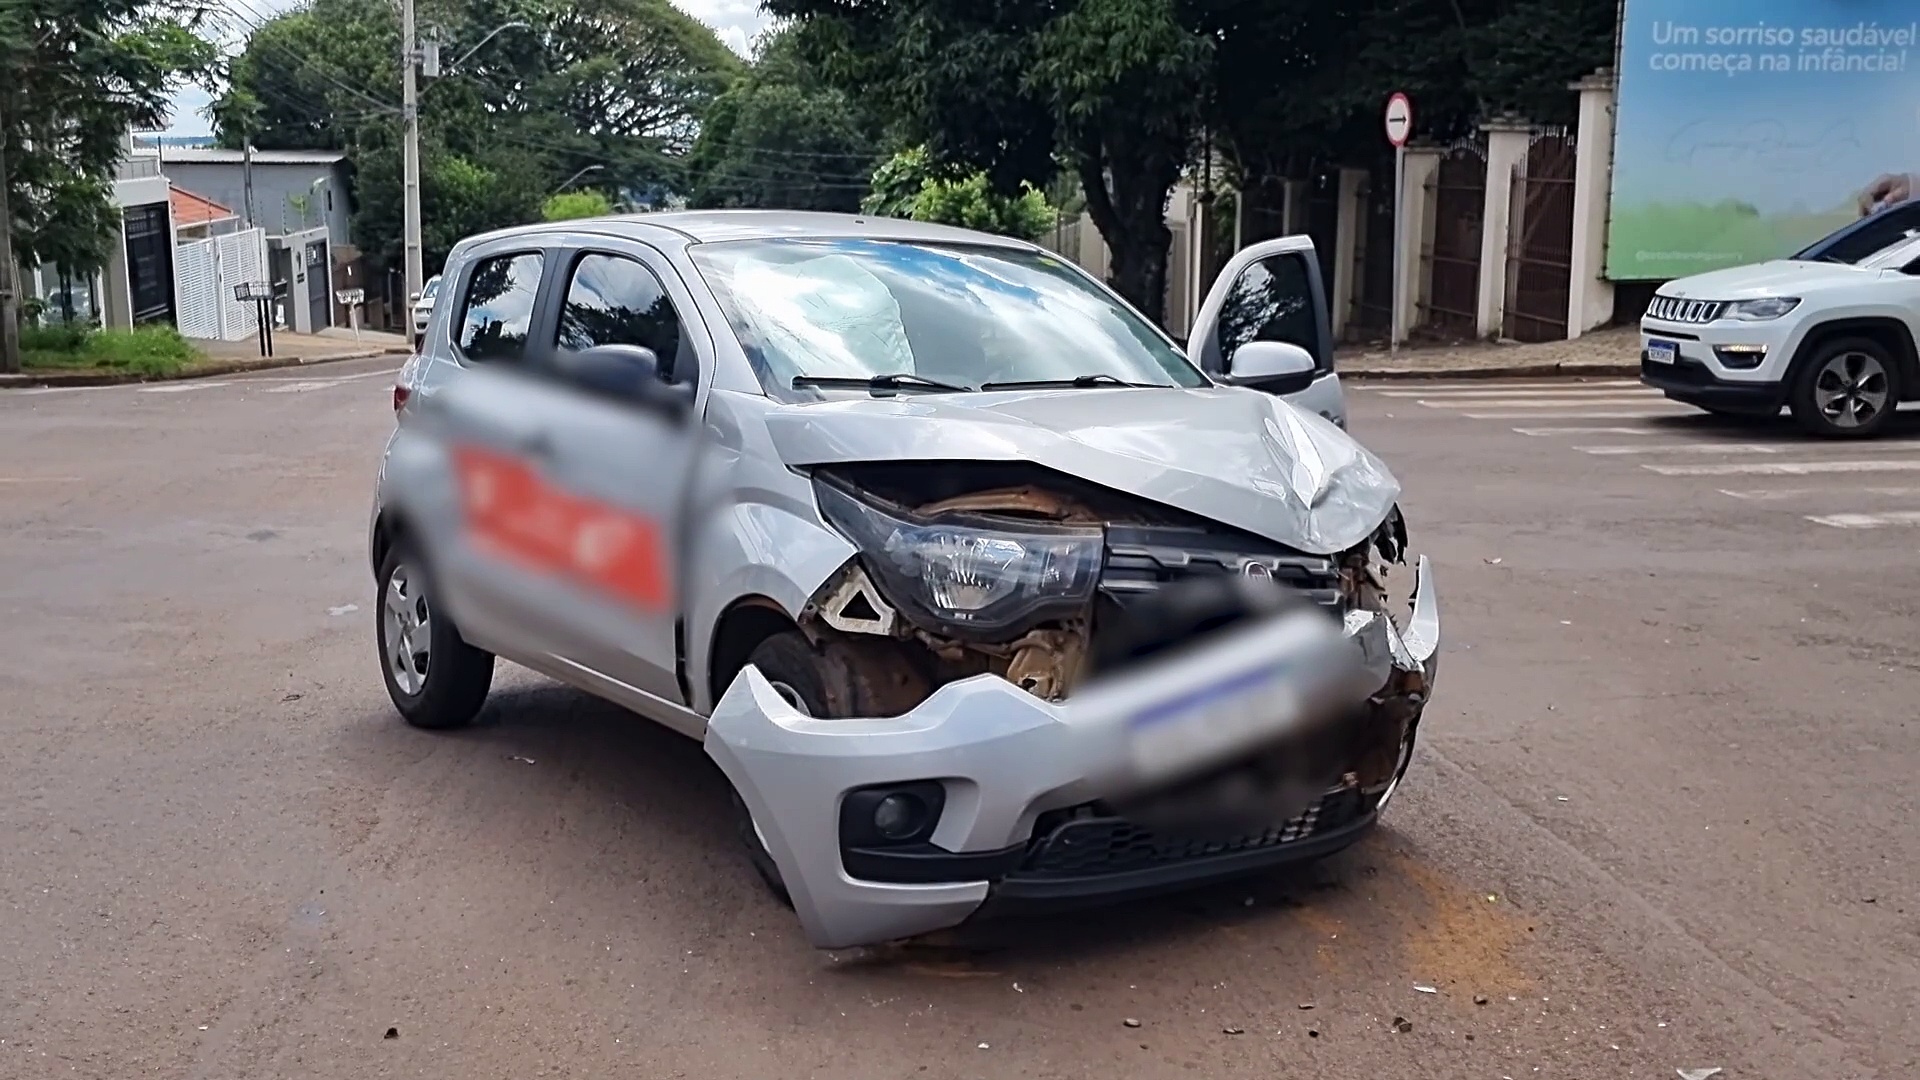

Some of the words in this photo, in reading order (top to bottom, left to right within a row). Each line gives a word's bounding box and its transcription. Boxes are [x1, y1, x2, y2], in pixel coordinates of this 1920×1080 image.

[1652, 21, 1697, 45] Um
[1705, 21, 1794, 46] sorriso
[1801, 22, 1916, 46] saudável
[1650, 52, 1751, 76] começa
[1759, 52, 1791, 71] na
[1798, 49, 1906, 72] infância!
